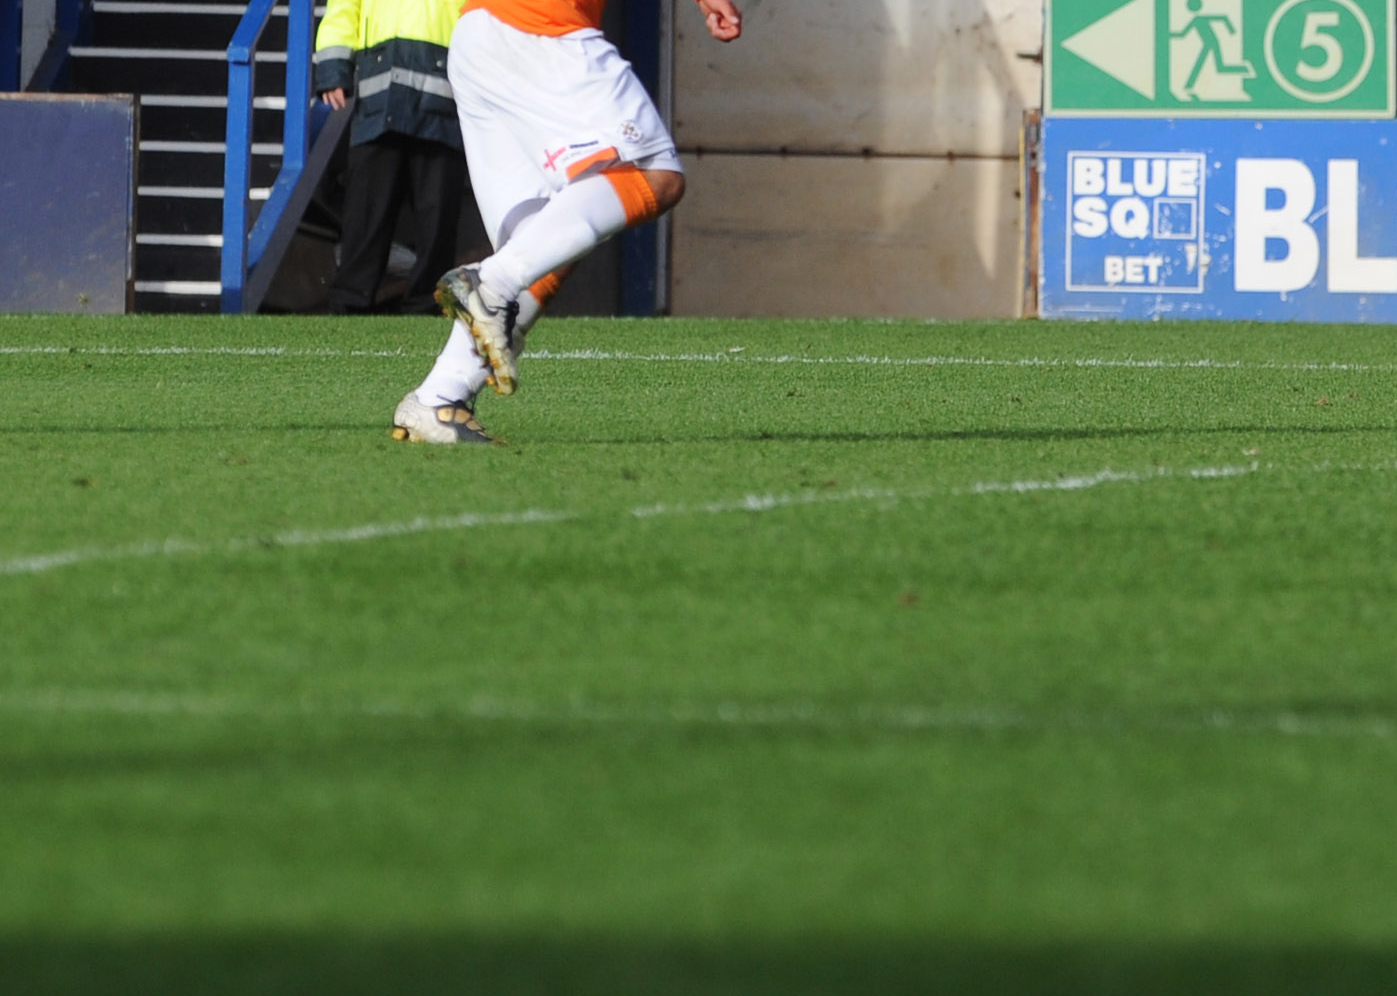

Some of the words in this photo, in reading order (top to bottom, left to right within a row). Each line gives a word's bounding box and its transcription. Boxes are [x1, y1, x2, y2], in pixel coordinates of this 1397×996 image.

[1295, 11, 1345, 83] 5
[1073, 157, 1199, 198] BLUE
[1073, 196, 1151, 240] SQ
[1104, 255, 1164, 284] BET
